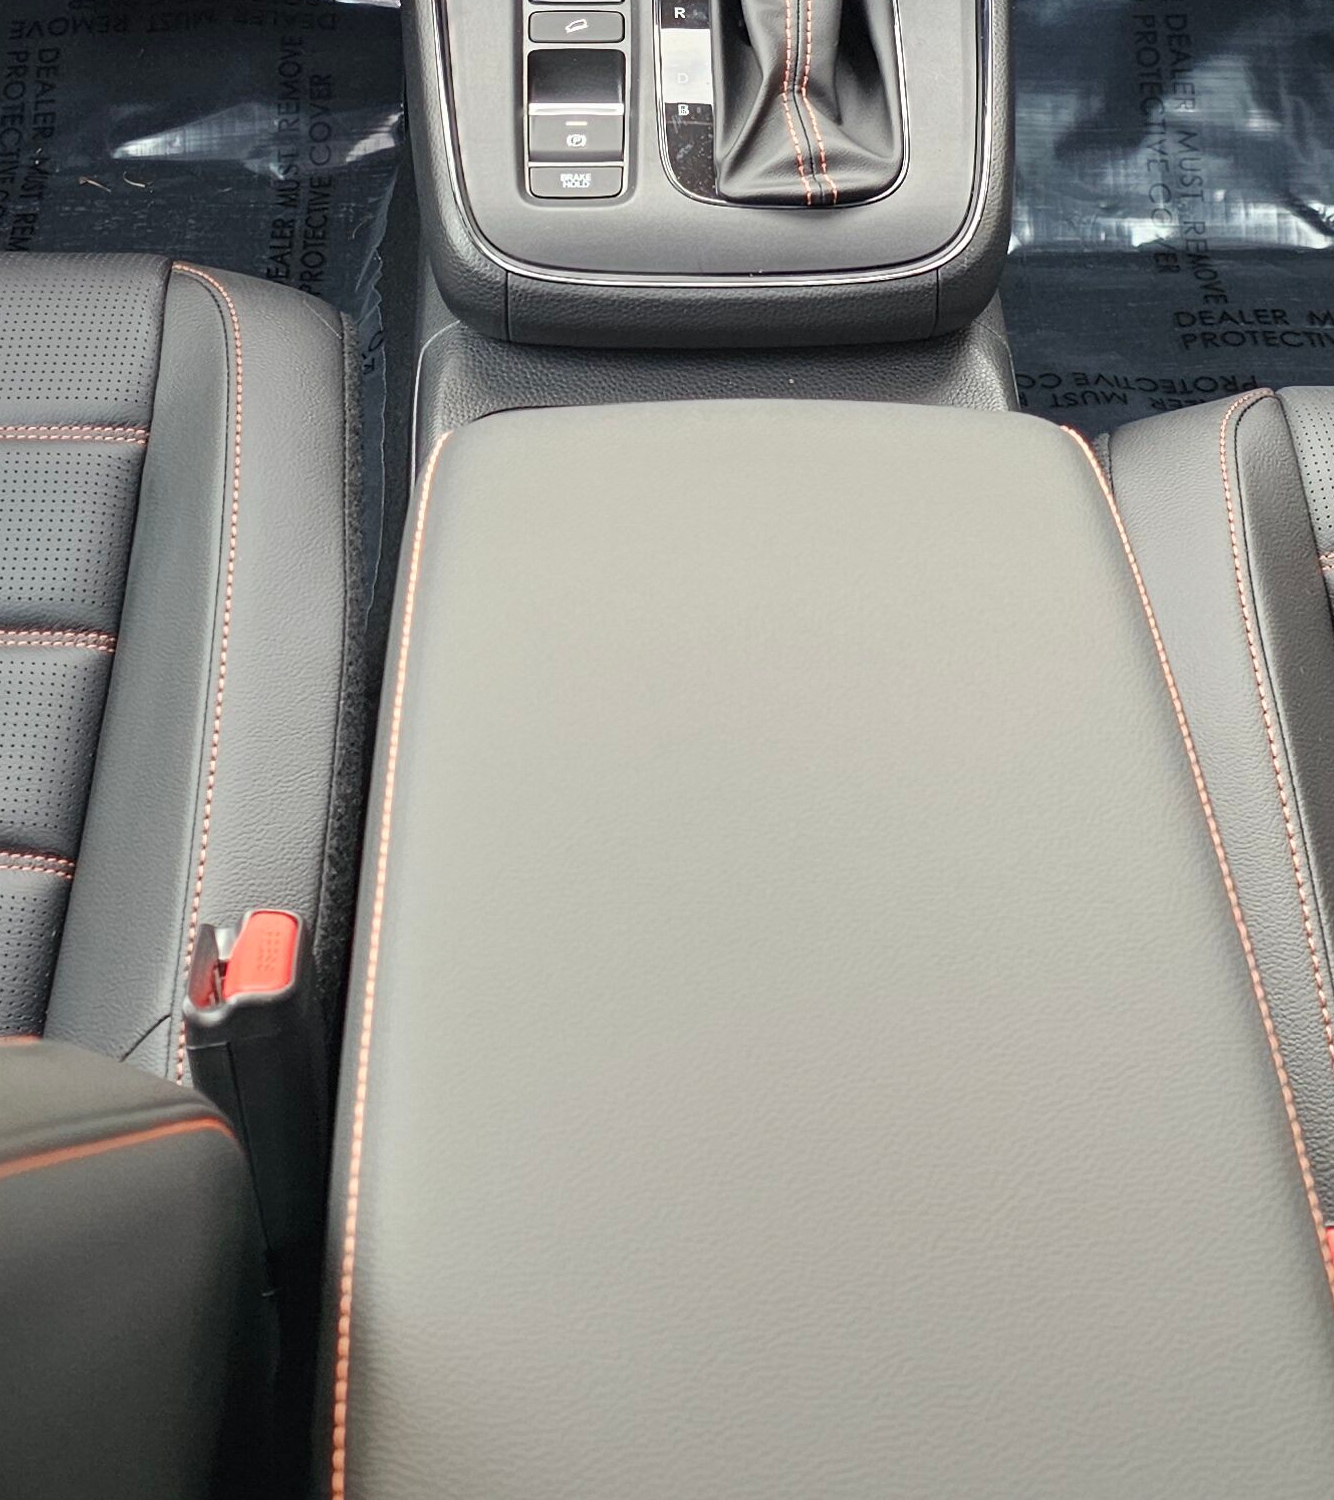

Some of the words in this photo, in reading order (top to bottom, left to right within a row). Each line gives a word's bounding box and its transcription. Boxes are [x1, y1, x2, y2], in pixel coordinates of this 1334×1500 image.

[8, 14, 129, 41] REMOVE
[673, 7, 686, 19] R
[31, 47, 62, 141] DEALER
[276, 34, 304, 134] REMOVE
[677, 72, 690, 84] D
[1132, 13, 1170, 173] PROTECTIVE
[1164, 13, 1197, 110] DEALER
[308, 73, 334, 167] COVER
[274, 147, 302, 208] MUST
[560, 173, 592, 182] BRAKE
[562, 180, 591, 189] HOLD
[1174, 129, 1205, 202] MUST
[298, 174, 334, 296] PROTECTIVE
[1182, 220, 1228, 306] REMOVE
[1174, 308, 1291, 329] DEALER
[1050, 388, 1129, 409] MUST
